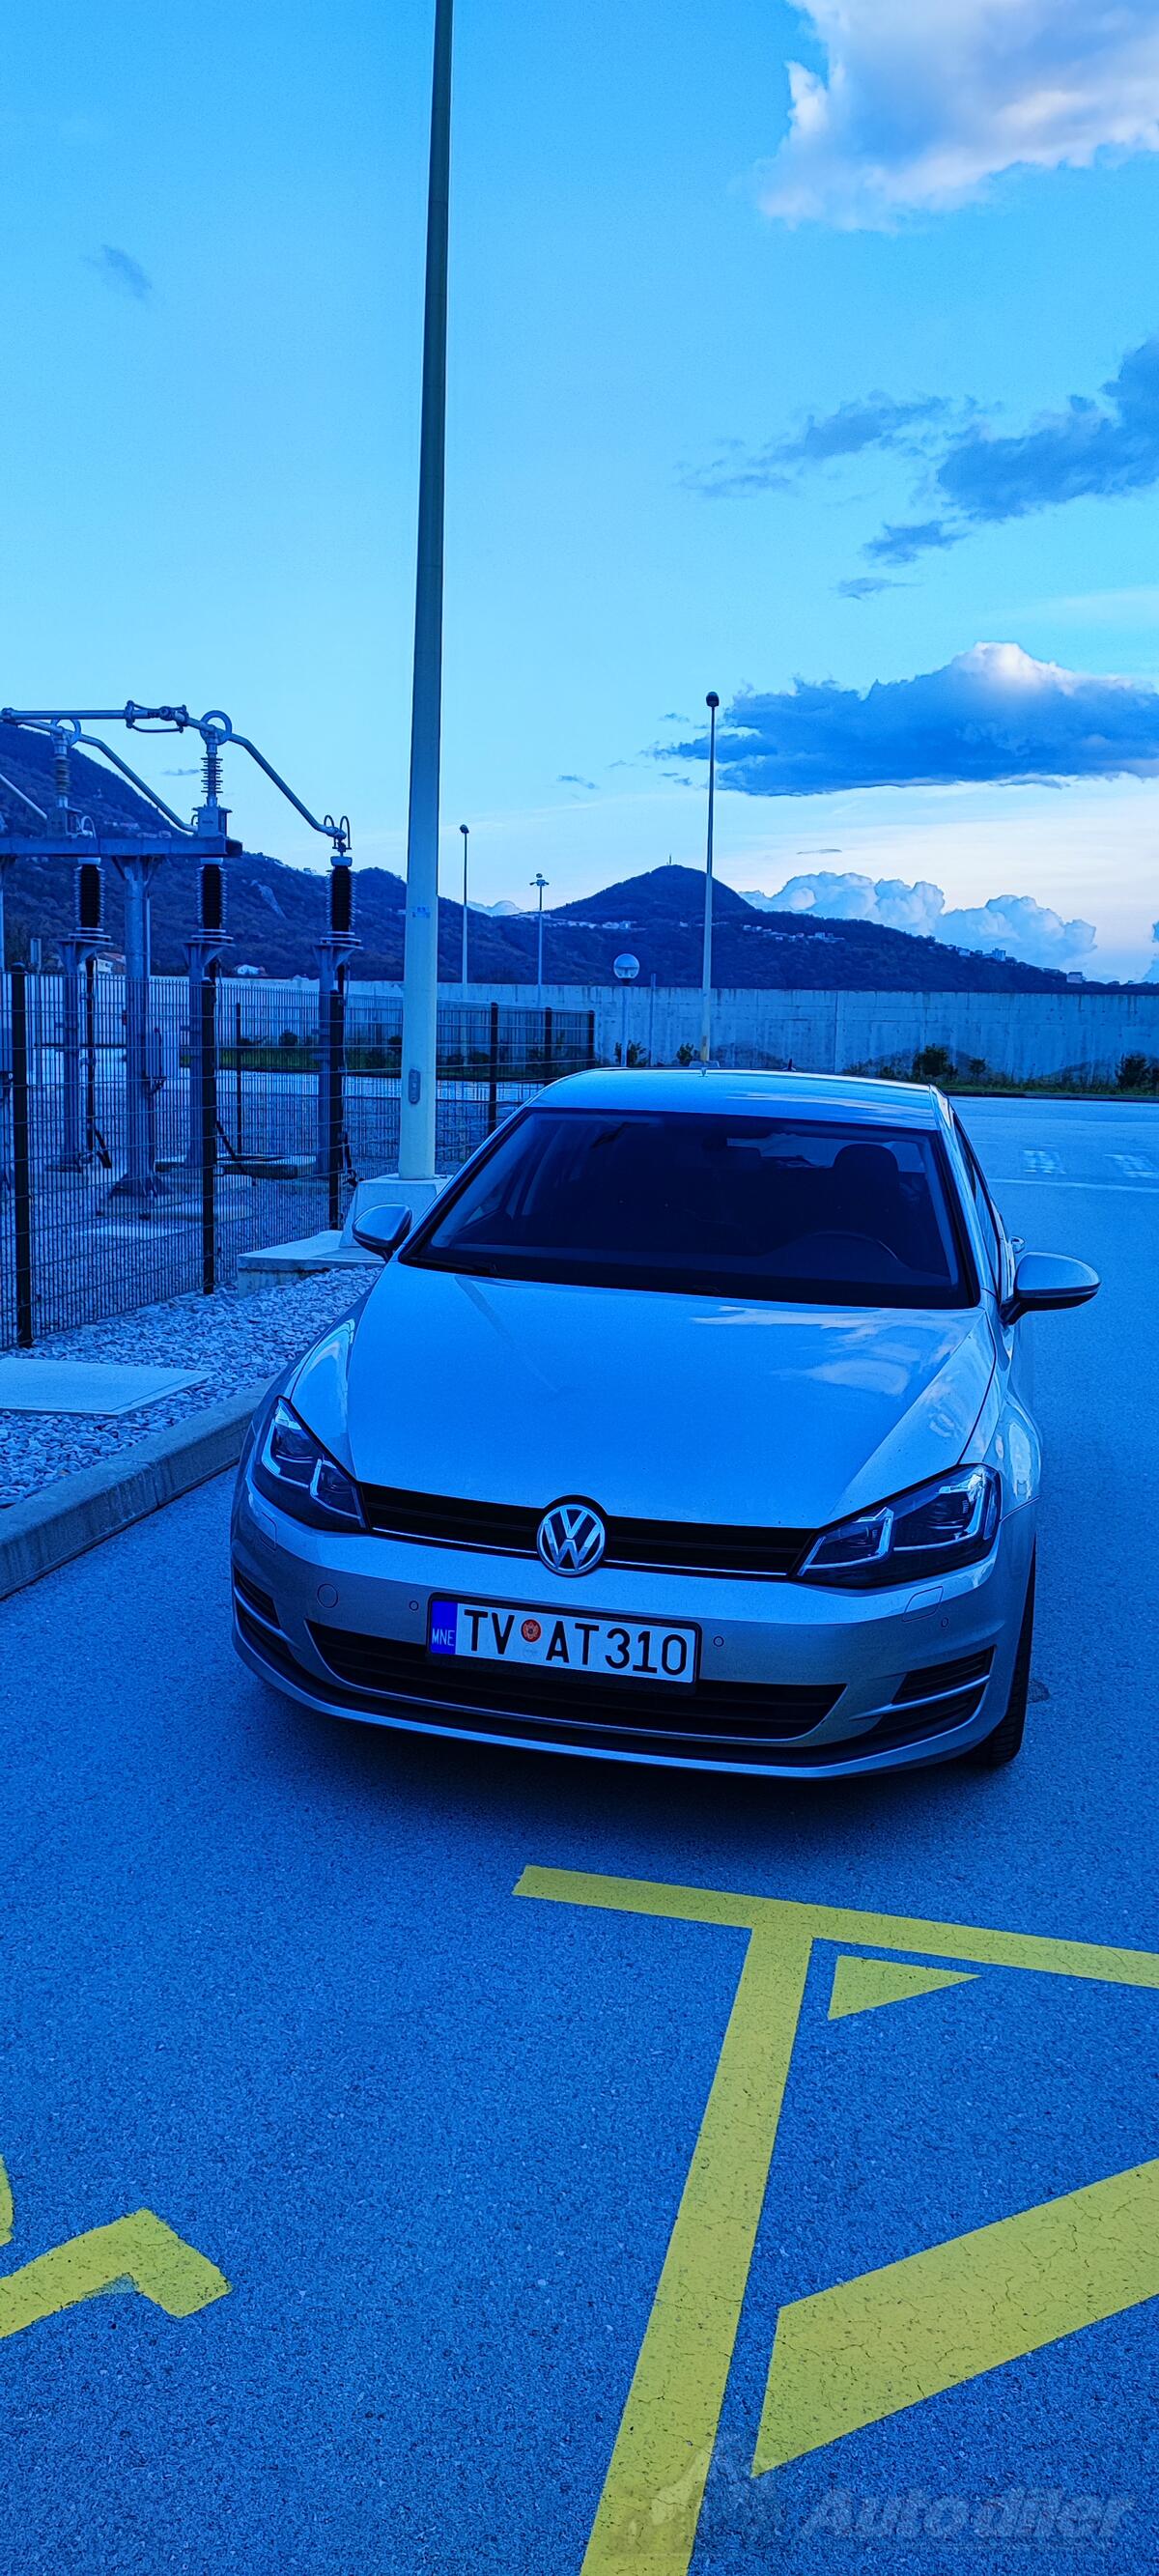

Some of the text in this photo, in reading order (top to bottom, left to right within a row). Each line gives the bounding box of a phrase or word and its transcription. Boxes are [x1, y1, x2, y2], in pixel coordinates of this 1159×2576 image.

[538, 1505, 605, 1574] VW
[431, 1628, 456, 1647] MNE
[464, 1608, 515, 1656] TV
